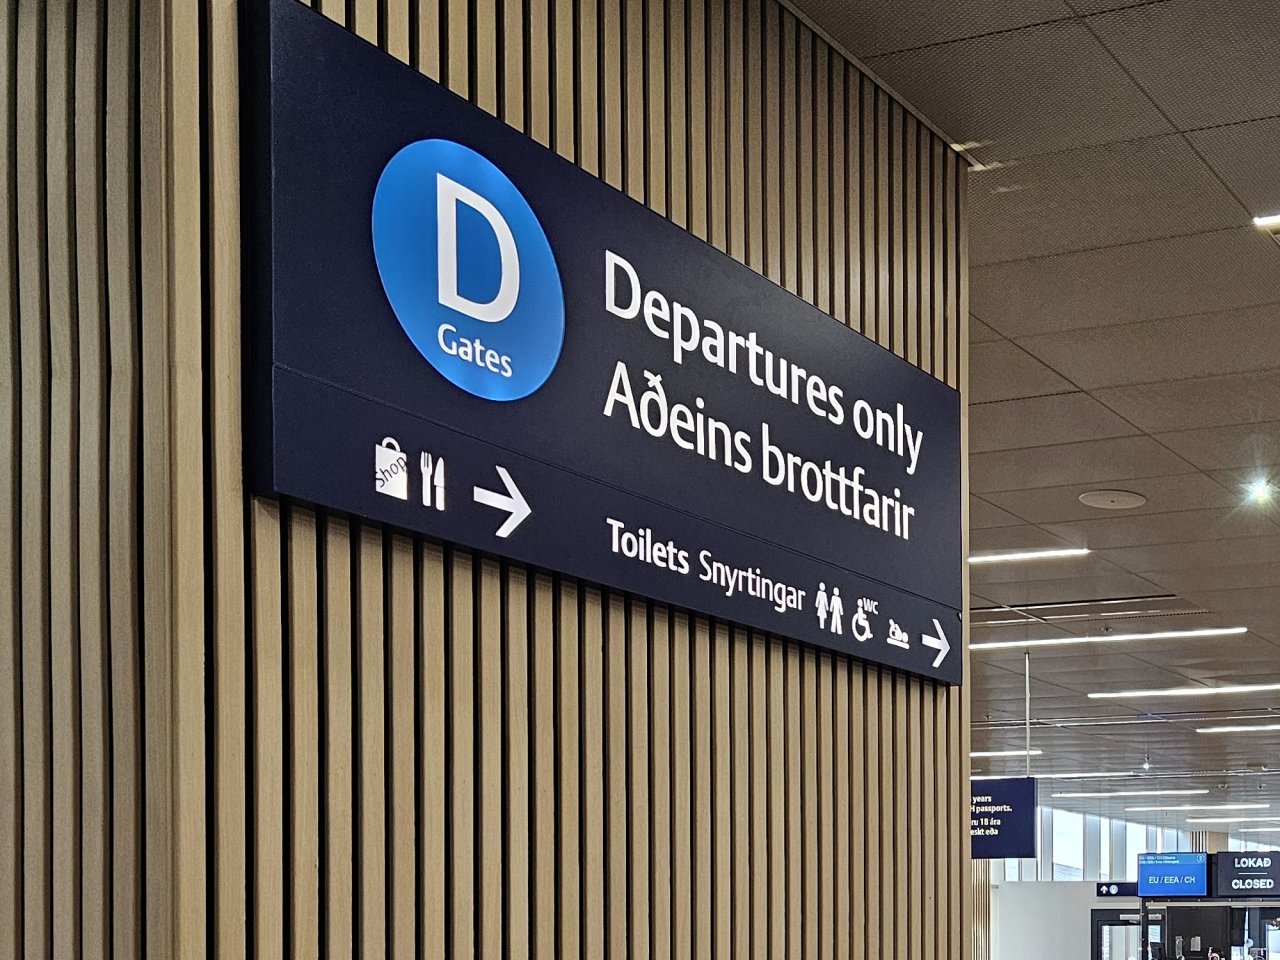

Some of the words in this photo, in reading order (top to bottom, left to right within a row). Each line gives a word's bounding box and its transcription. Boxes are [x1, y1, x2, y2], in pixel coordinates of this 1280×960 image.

[437, 172, 520, 322] D
[437, 323, 512, 378] Gates
[605, 249, 845, 426] Departures
[853, 399, 923, 475] only
[603, 360, 753, 474] Aðeins
[762, 422, 915, 541] brottfarir
[375, 456, 407, 488] Shop
[606, 517, 689, 574] Toilets
[699, 549, 806, 613] Snyrtingar
[863, 597, 879, 615] WC
[972, 796, 992, 804] years
[976, 804, 1013, 813] passports.
[980, 818, 989, 826] 18
[1234, 857, 1272, 868] LOKAÐ
[1149, 876, 1159, 884] EU
[1164, 876, 1179, 884] EEA
[1184, 875, 1196, 884] CH
[1231, 878, 1275, 889] CLOSED
